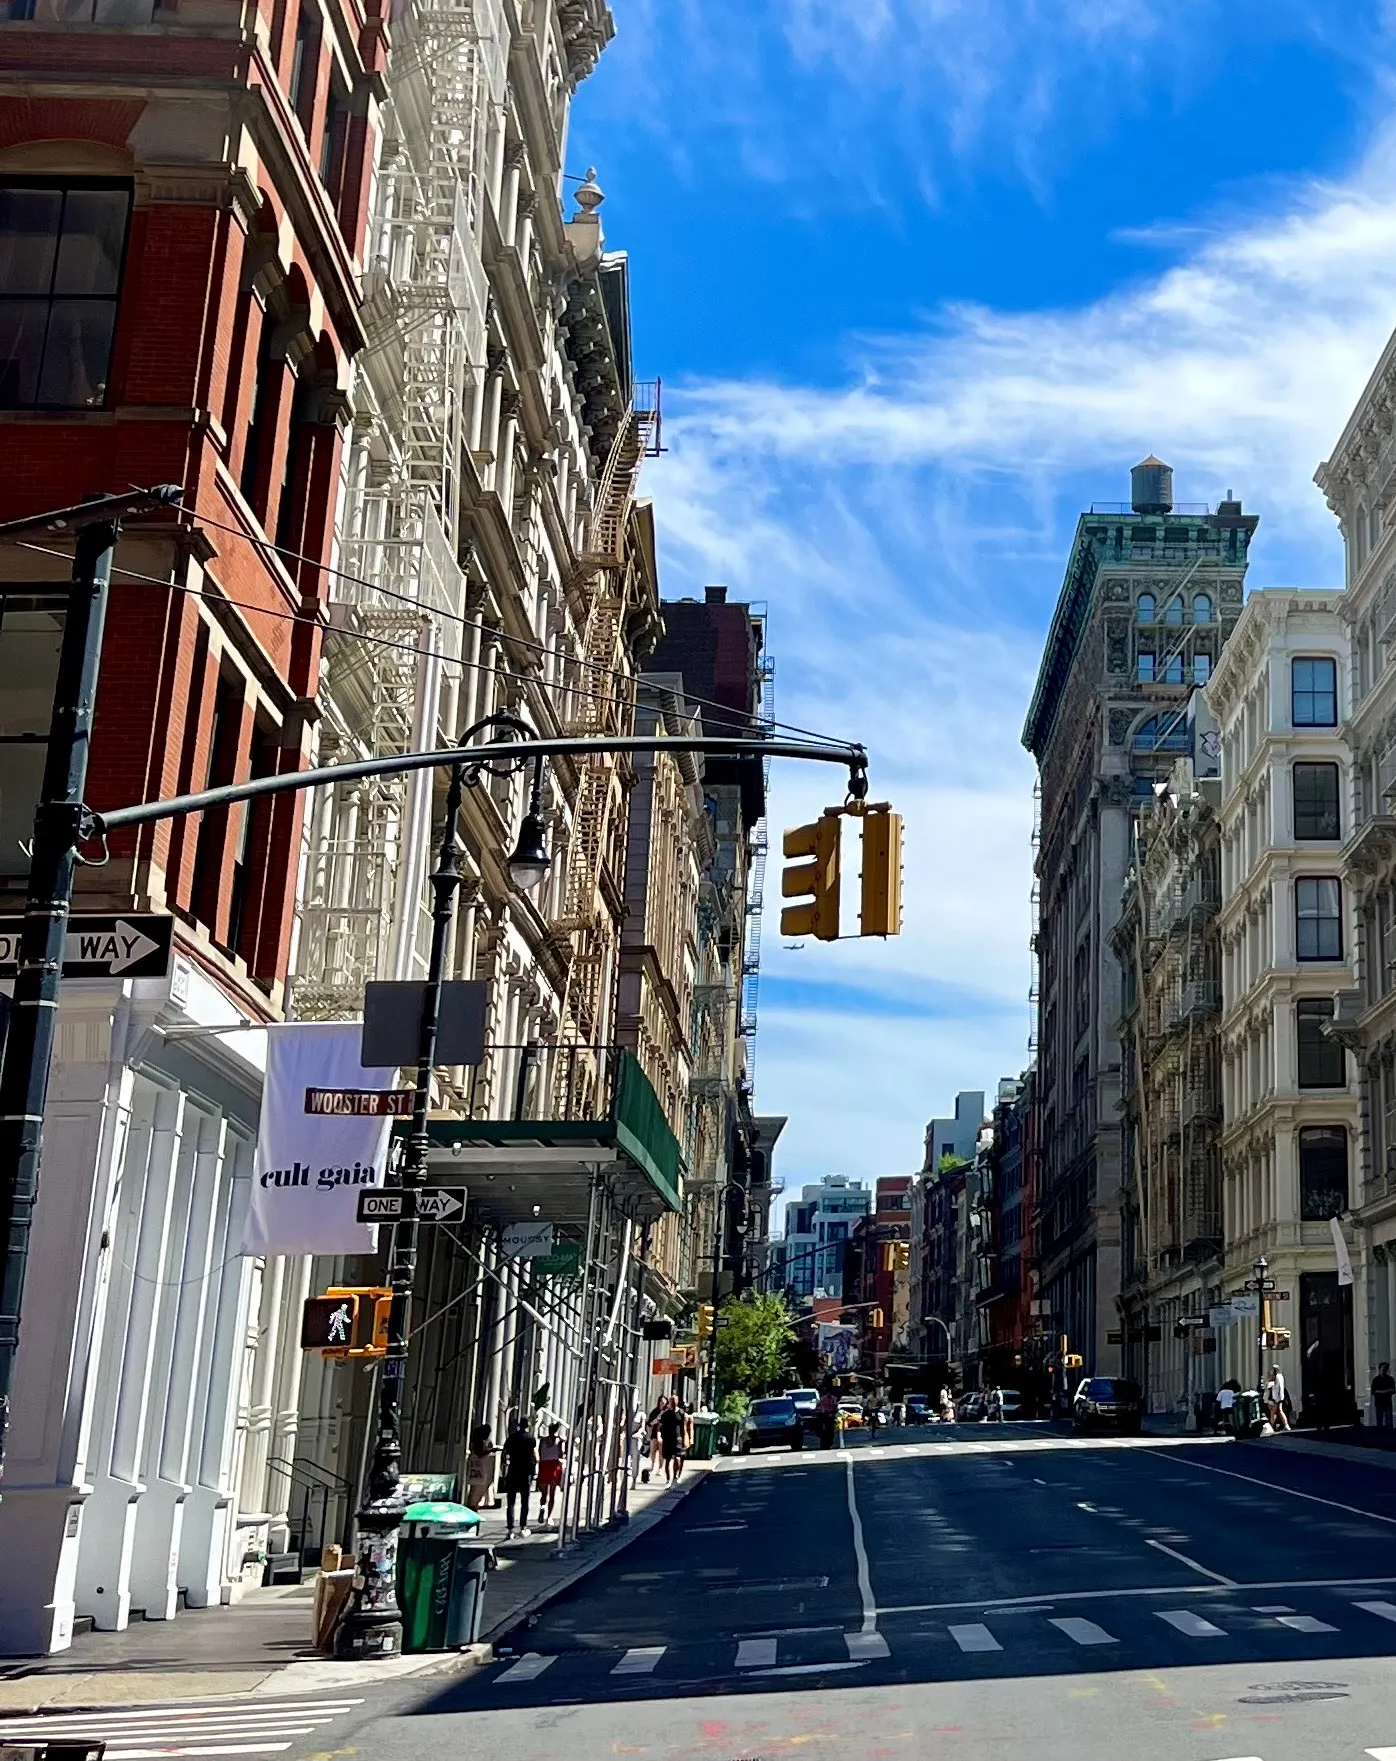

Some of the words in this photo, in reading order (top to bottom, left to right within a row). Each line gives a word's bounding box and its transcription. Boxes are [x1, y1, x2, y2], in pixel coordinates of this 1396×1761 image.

[80, 935, 142, 961] WAY
[311, 1092, 380, 1115] WOOSTER
[387, 1094, 406, 1113] ST
[260, 1162, 311, 1189] cult
[315, 1161, 375, 1191] gaia
[367, 1198, 400, 1213] ONE
[419, 1198, 451, 1212] WAY
